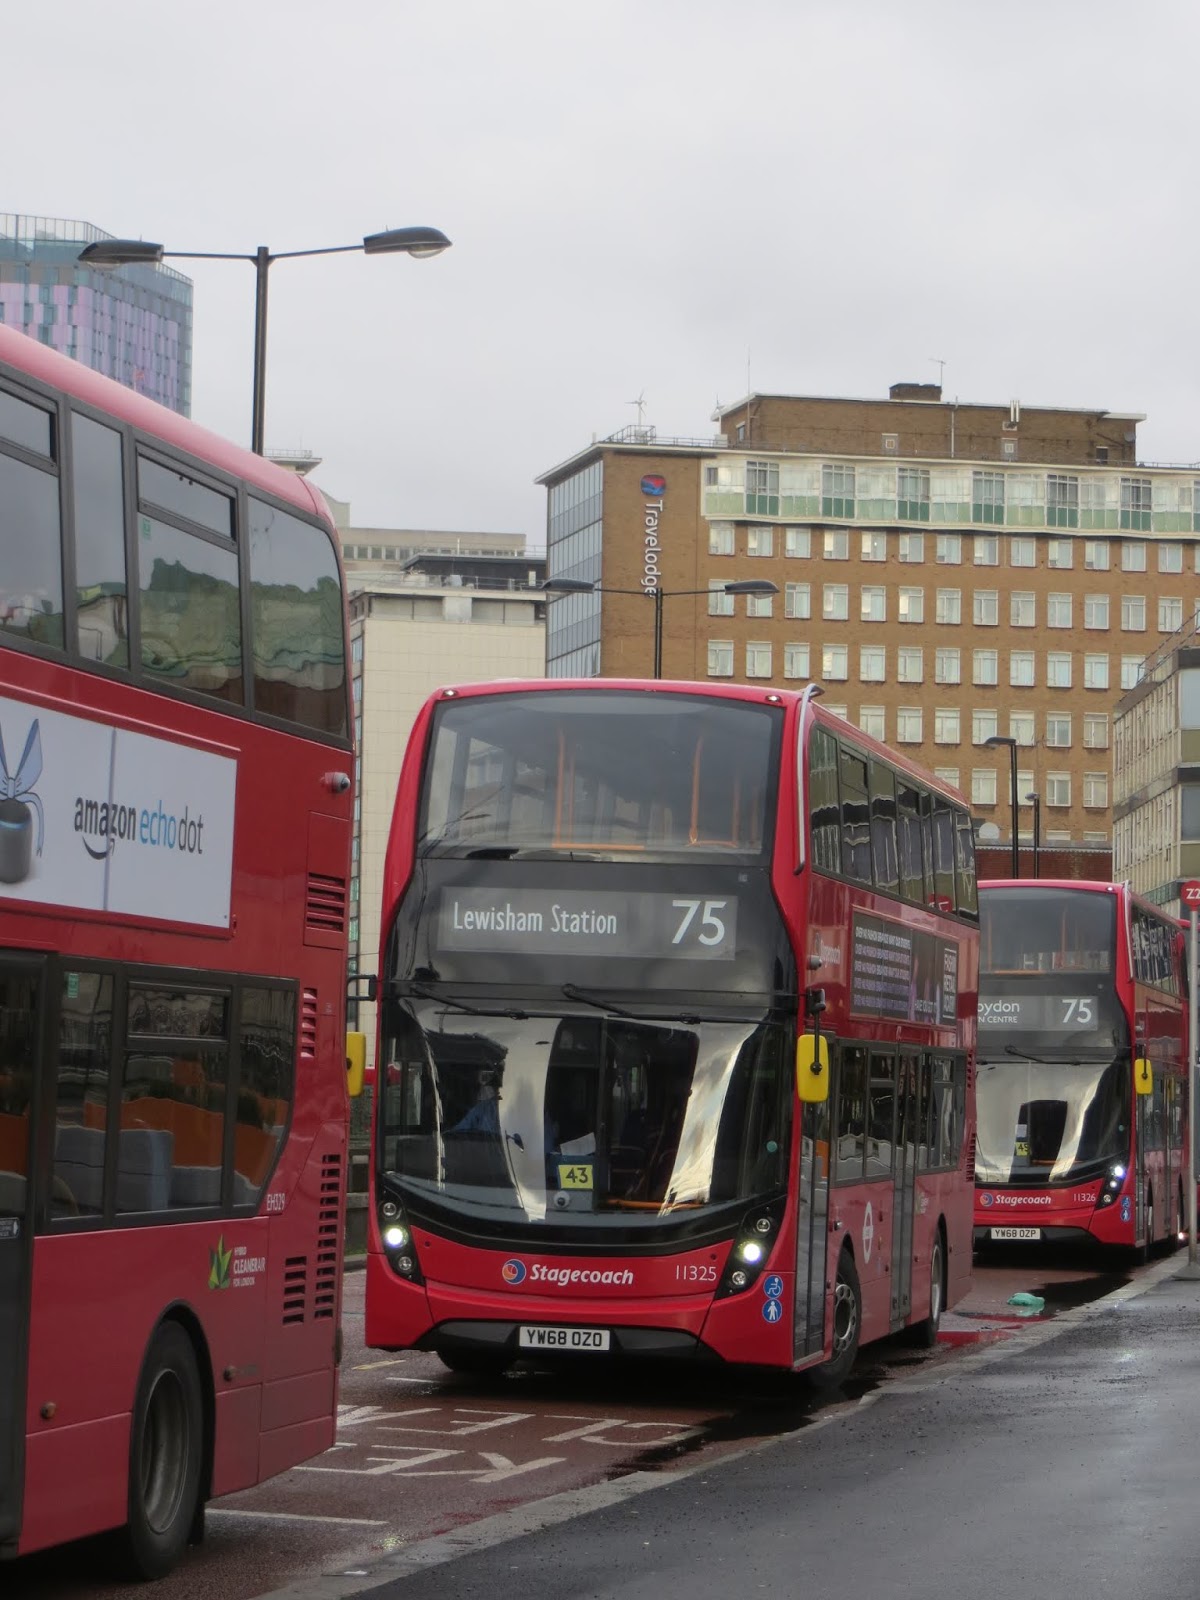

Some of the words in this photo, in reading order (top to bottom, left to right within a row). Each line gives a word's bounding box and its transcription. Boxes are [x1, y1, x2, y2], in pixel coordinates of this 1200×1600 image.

[641, 499, 663, 598] Travelodge
[74, 797, 137, 841] amazon
[139, 799, 177, 849] echo
[178, 805, 204, 854] dot
[453, 901, 543, 932] Lewisham
[550, 904, 618, 934] Station
[671, 899, 727, 946] 75
[978, 999, 1020, 1016] oydon
[1062, 998, 1092, 1023] 75
[987, 1016, 1018, 1024] CENTRE
[565, 1167, 589, 1184] 43
[995, 1194, 1052, 1207] Stagecoach
[1073, 1193, 1096, 1202] 11326
[994, 1229, 1017, 1238] YW68
[1019, 1229, 1037, 1238] OZP
[529, 1264, 634, 1287] Stagecoach
[675, 1265, 717, 1282] 11325
[527, 1329, 567, 1346] YW68
[571, 1331, 603, 1347] OZO
[336, 1404, 712, 1447] CLEA
[291, 1442, 567, 1483] KE
